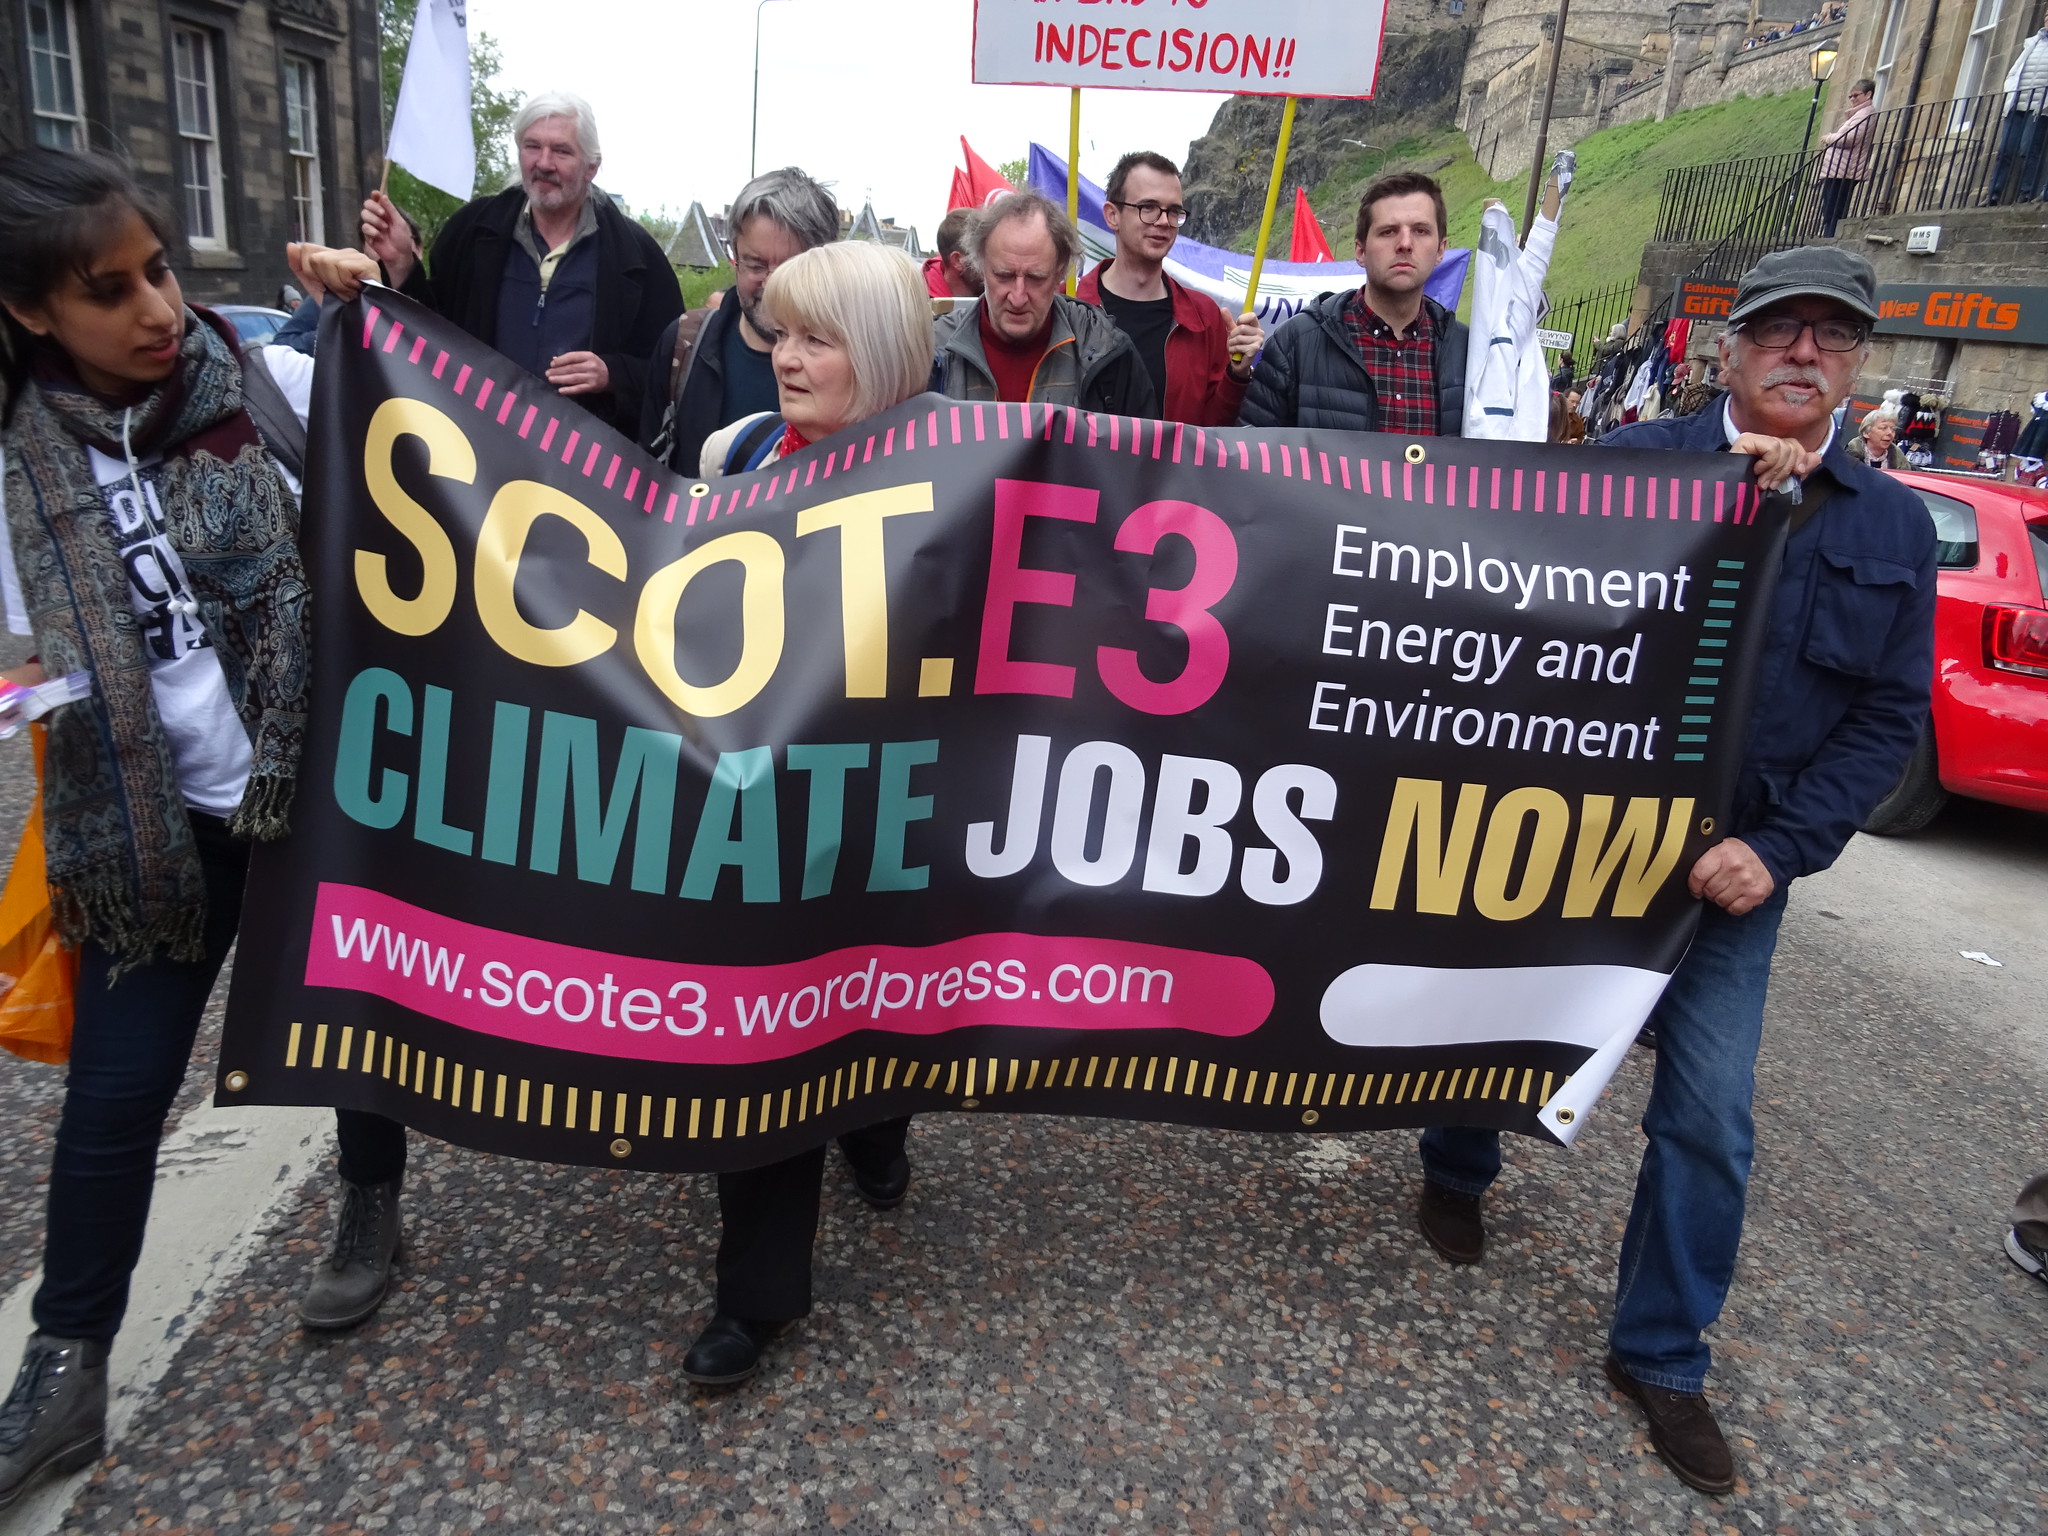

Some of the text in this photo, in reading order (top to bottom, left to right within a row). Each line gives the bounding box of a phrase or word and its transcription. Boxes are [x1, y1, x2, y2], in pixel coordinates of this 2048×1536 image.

[1034, 21, 1297, 78] INDECISION!!
[1547, 332, 1570, 341] WYND
[1879, 291, 2021, 331] Wee Gifts
[1332, 524, 1691, 612] Employment
[1322, 603, 1642, 685] Energy and
[1308, 681, 1660, 761] Environment
[334, 667, 1696, 922] CLIMATE JOBS NOW
[331, 914, 1173, 1037] www.scote3.wordpress.com
